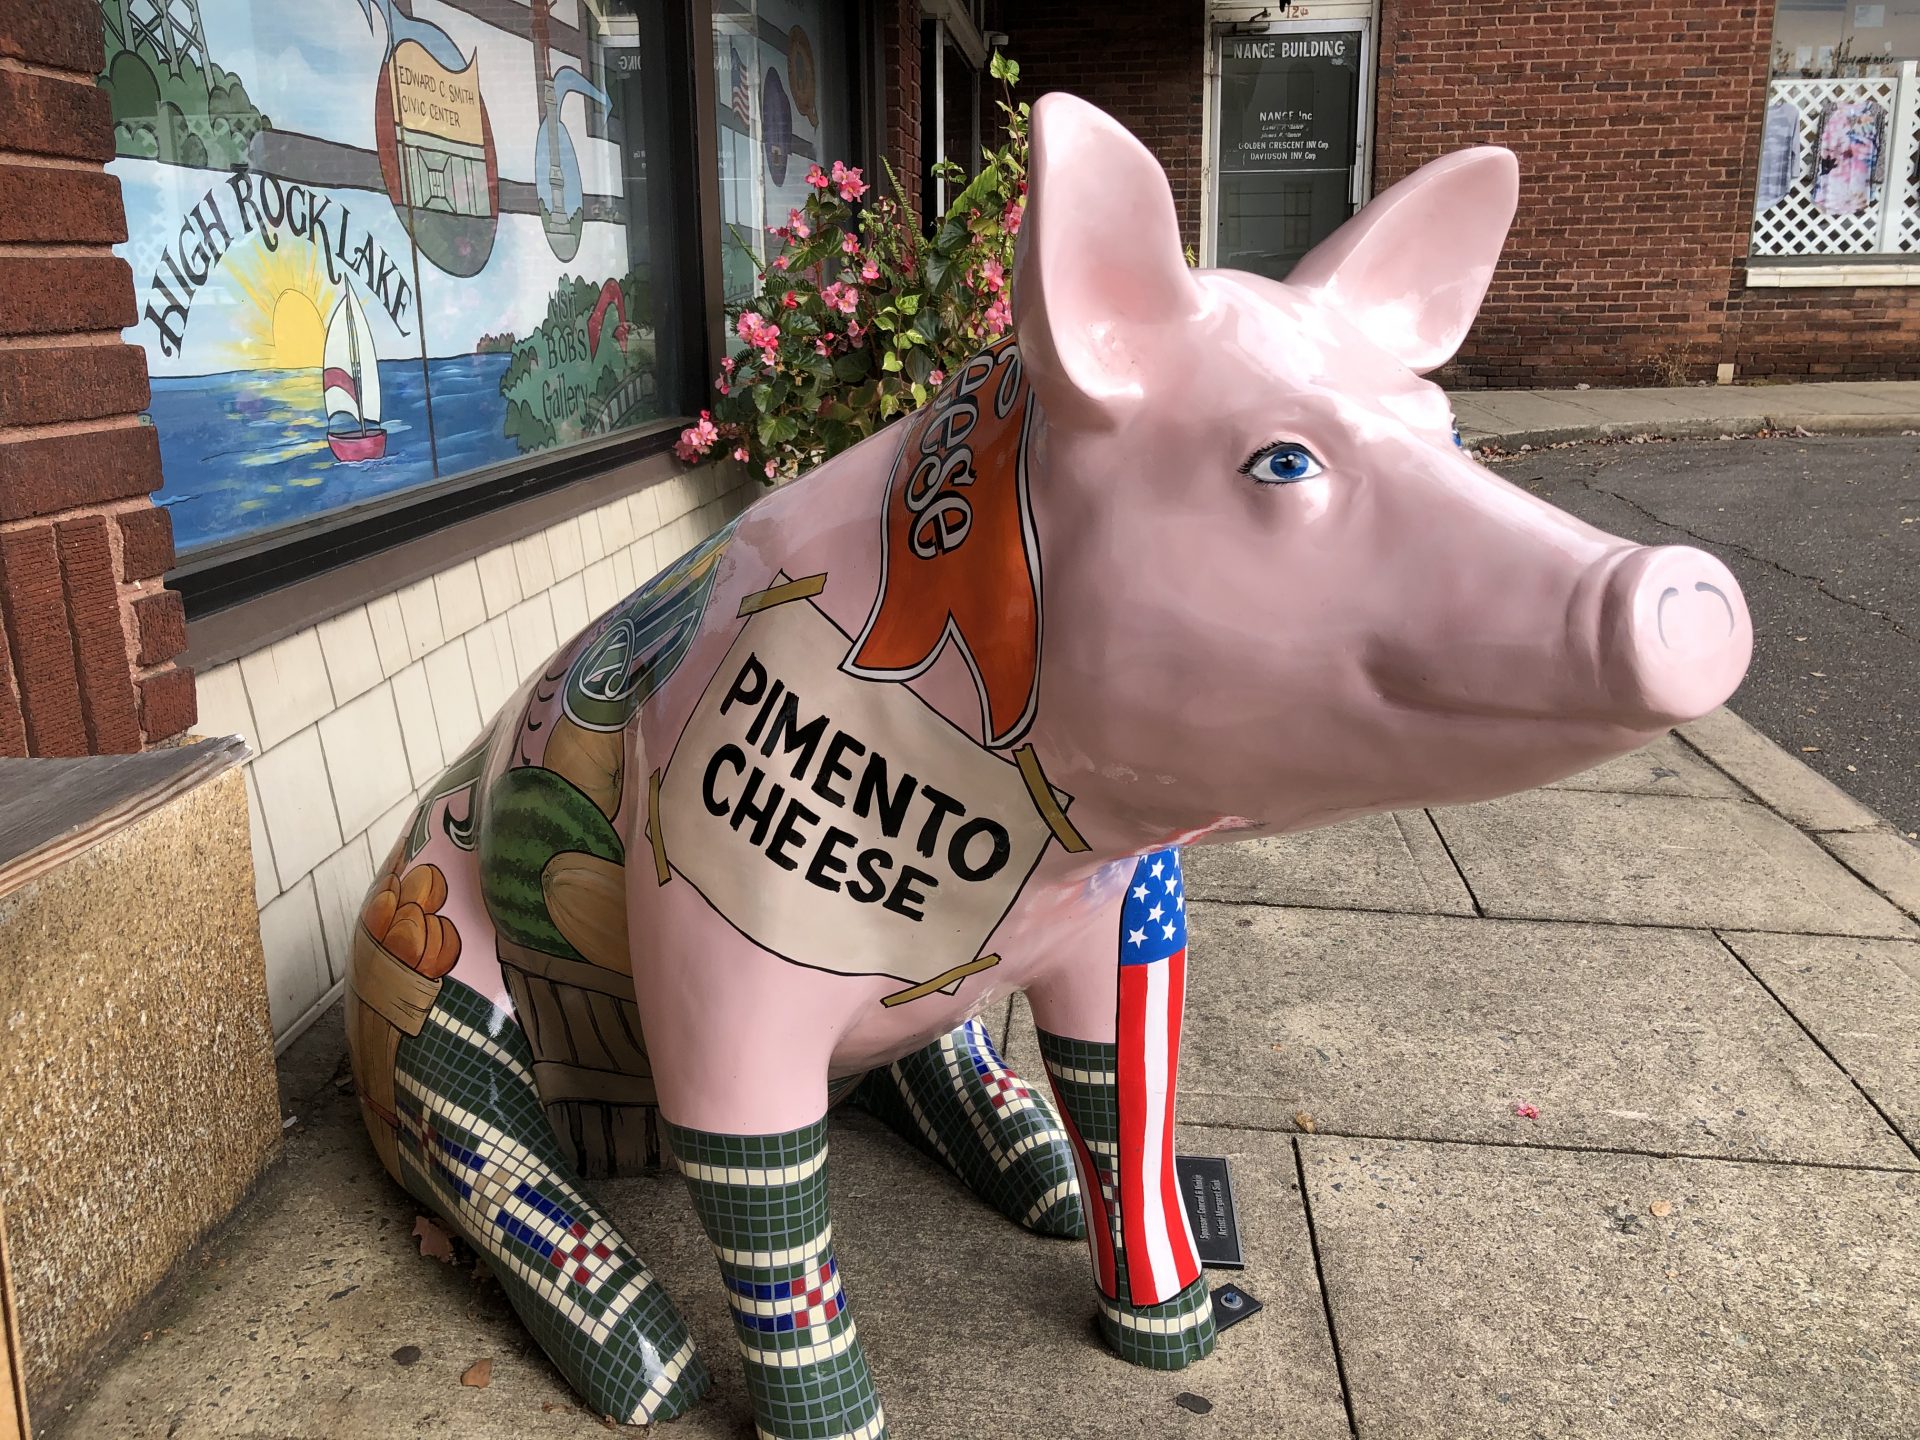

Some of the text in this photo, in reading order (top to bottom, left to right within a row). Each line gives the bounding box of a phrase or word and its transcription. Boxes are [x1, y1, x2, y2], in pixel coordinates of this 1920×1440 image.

[1233, 40, 1346, 59] NANCE BUILDING
[398, 65, 437, 93] EDWARD
[448, 84, 475, 105] SMITH
[401, 95, 461, 128] CIVIC CENTER
[1259, 111, 1295, 121] NANCE
[1238, 141, 1266, 150] GOLDEN
[1268, 140, 1305, 149] CRESCENT
[1250, 152, 1288, 161] DAVIDSON
[143, 165, 413, 359] HIGH ROCK LAKE
[548, 290, 579, 323] VISIT
[543, 328, 588, 370] BOB'S
[542, 372, 589, 426] Gallery
[719, 652, 1011, 882] PIMENTO
[702, 743, 939, 922] CHEESE
[1213, 1190, 1225, 1217] Margaret
[1216, 1217, 1228, 1237] Artist:
